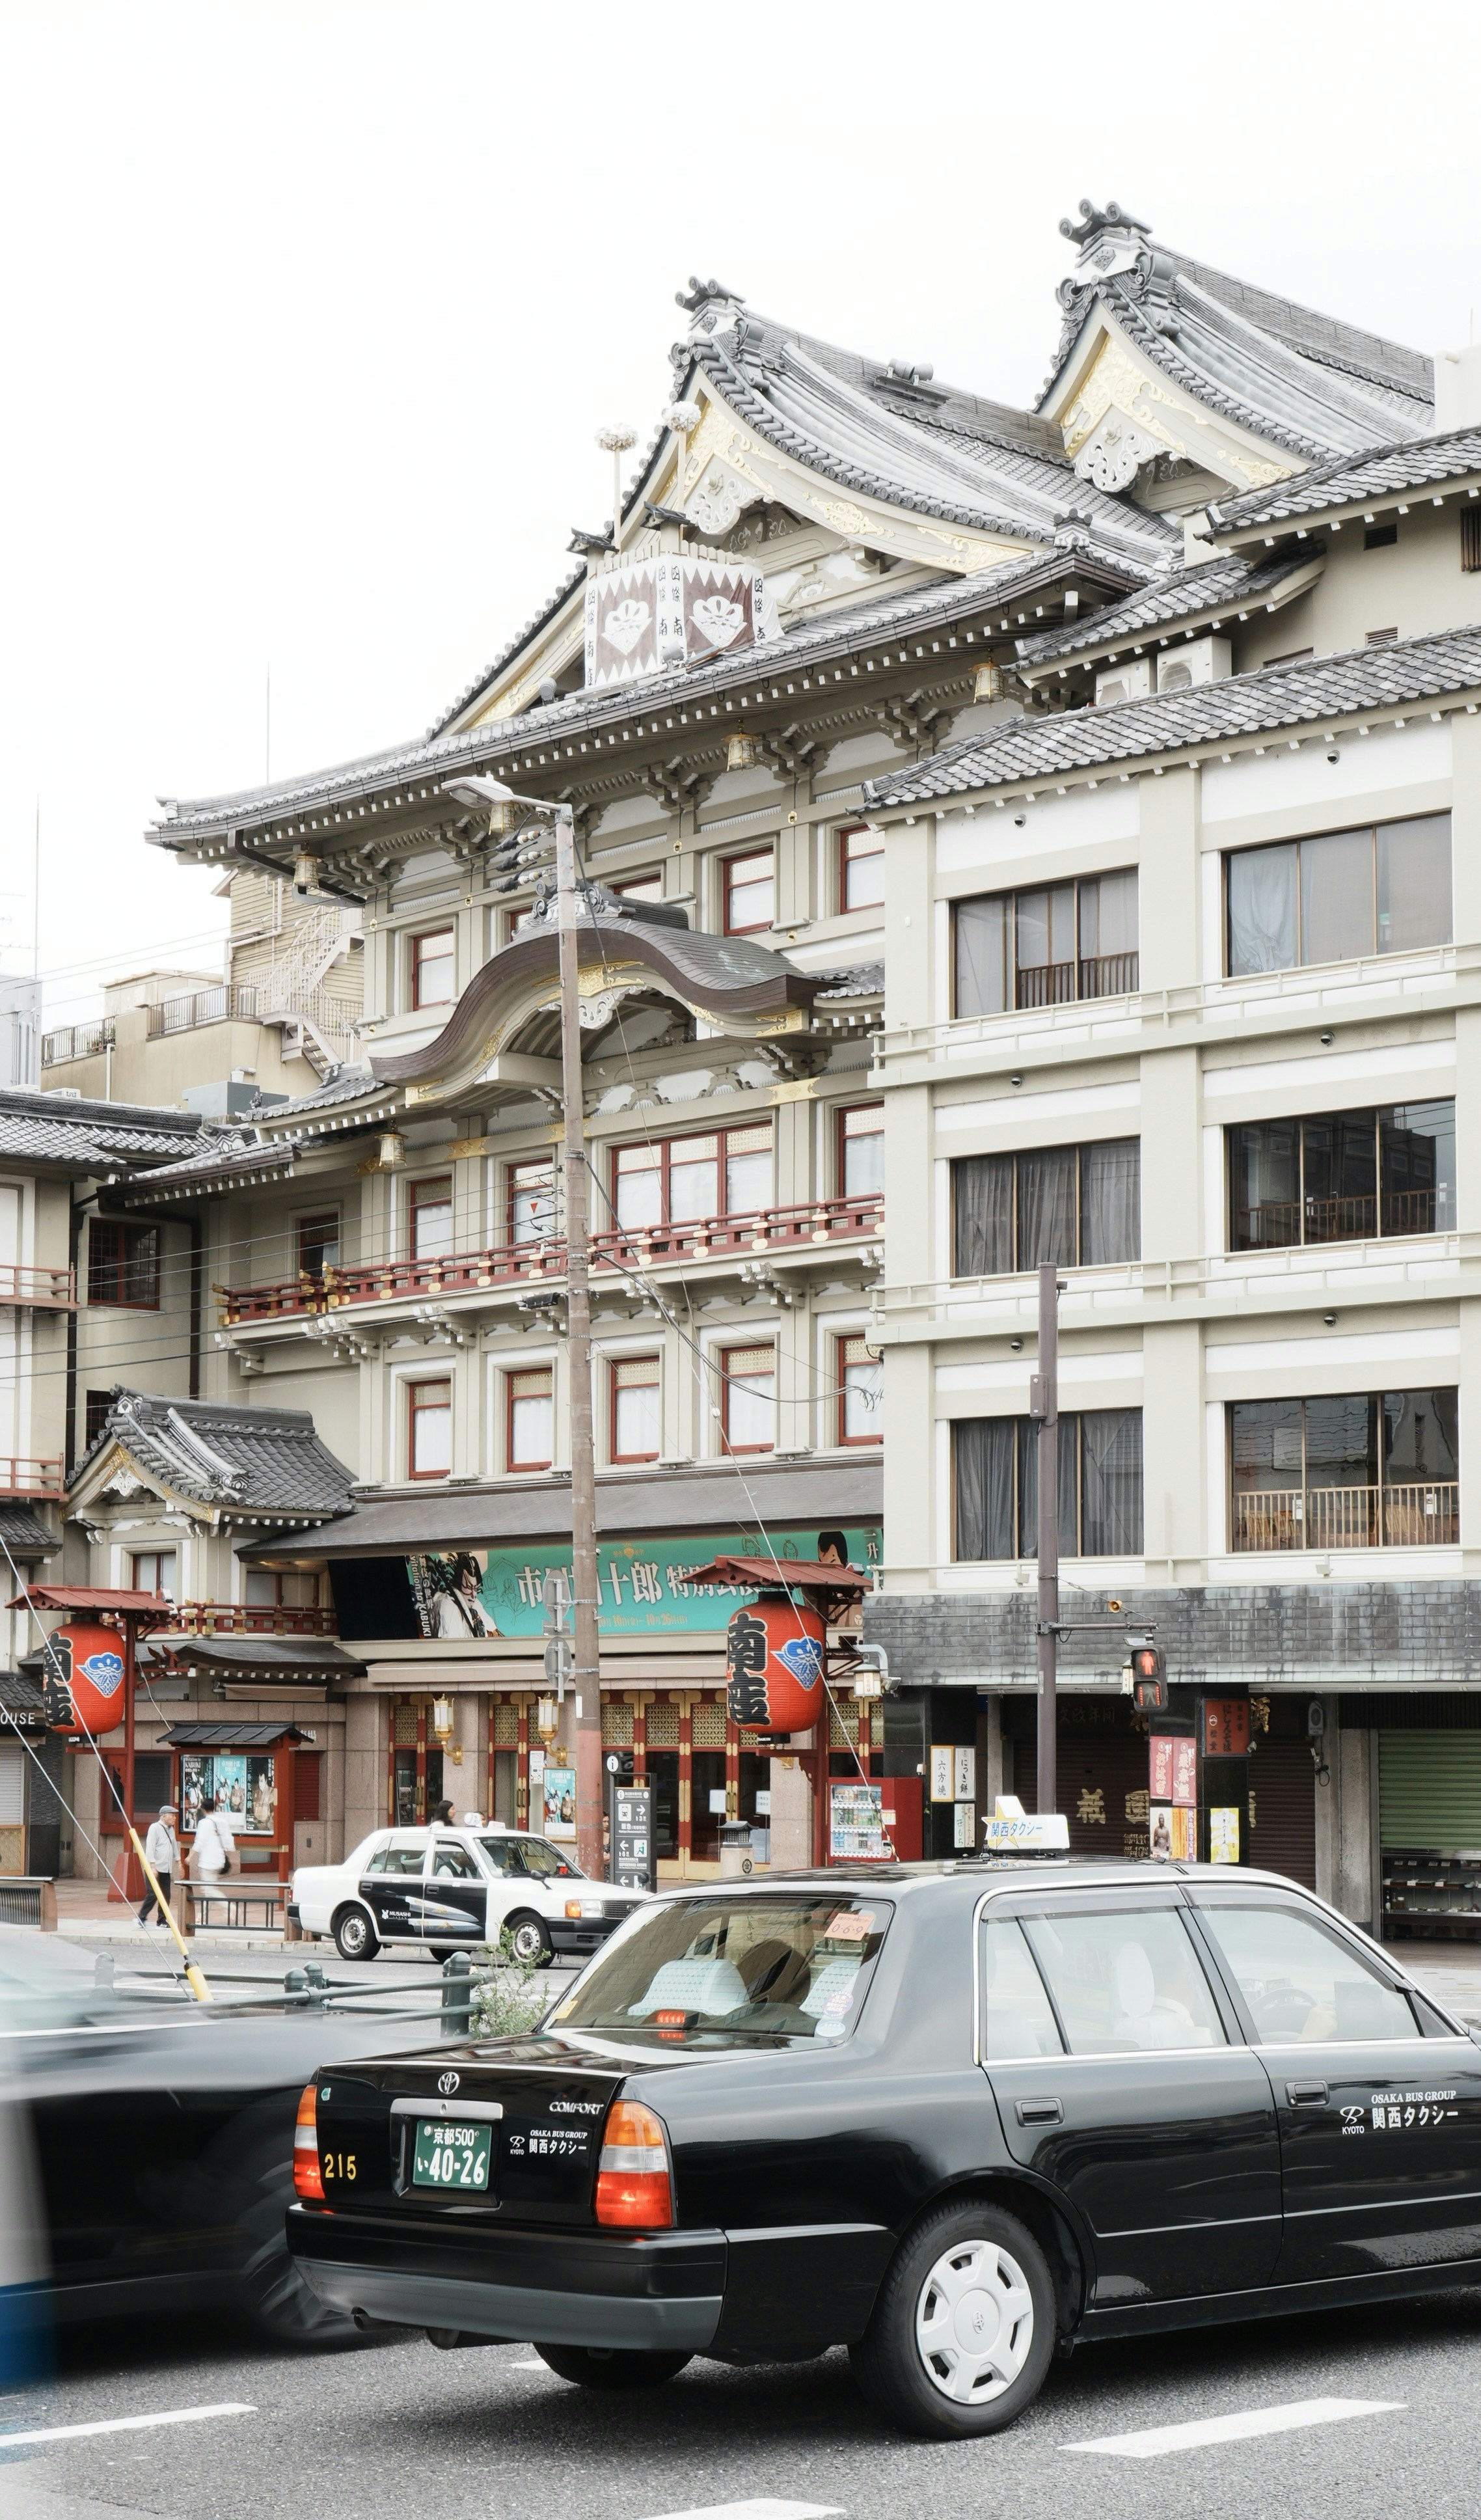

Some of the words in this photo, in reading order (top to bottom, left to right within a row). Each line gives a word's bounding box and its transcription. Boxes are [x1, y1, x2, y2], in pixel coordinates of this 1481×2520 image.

[659, 565, 668, 654] 四條南
[671, 565, 683, 654] 四條南
[418, 1603, 431, 1637] KABUKI
[43, 1632, 76, 1727] 南座
[727, 1611, 772, 1726] 南座
[938, 1760, 946, 1796] 六方焼
[991, 1822, 1043, 1837] 関西タクシー
[549, 2102, 604, 2115] COMFORT
[1371, 2093, 1404, 2104] OSAKA
[1405, 2092, 1423, 2102] BUS
[1424, 2090, 1457, 2101] GROUP
[1342, 2126, 1365, 2135] KYOTO
[1372, 2105, 1459, 2130] 関西タクシー
[530, 2129, 551, 2137] OSAKA
[529, 2138, 587, 2155] 関西タクシー
[324, 2153, 357, 2180] 215
